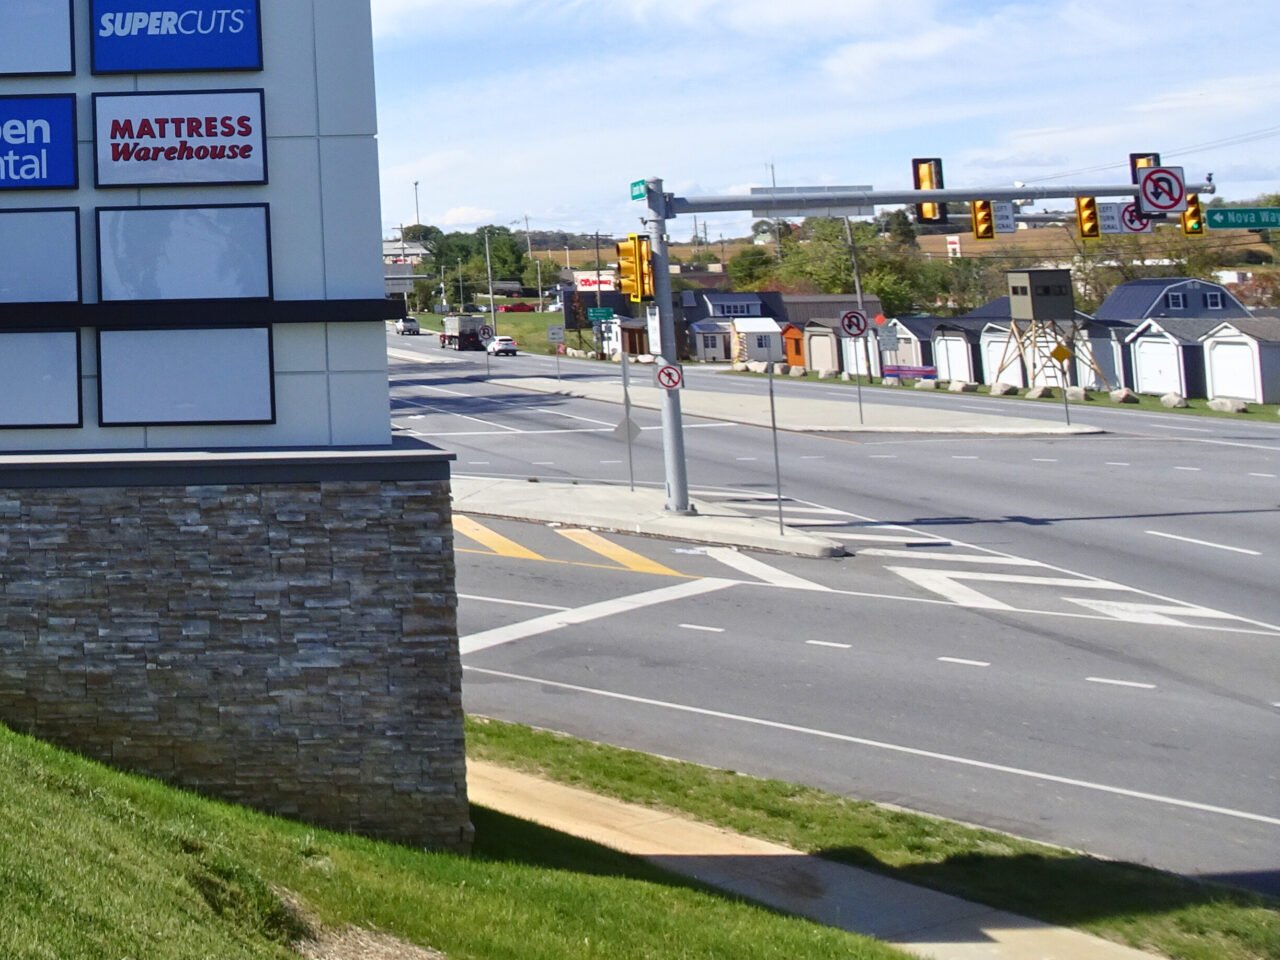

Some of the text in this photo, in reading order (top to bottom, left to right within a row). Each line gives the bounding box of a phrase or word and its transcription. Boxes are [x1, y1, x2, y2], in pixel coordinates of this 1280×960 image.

[98, 9, 245, 37] SUPERCUTS
[110, 115, 253, 140] MATTRESS
[110, 140, 253, 163] Warehouse
[1228, 211, 1255, 223] Nova
